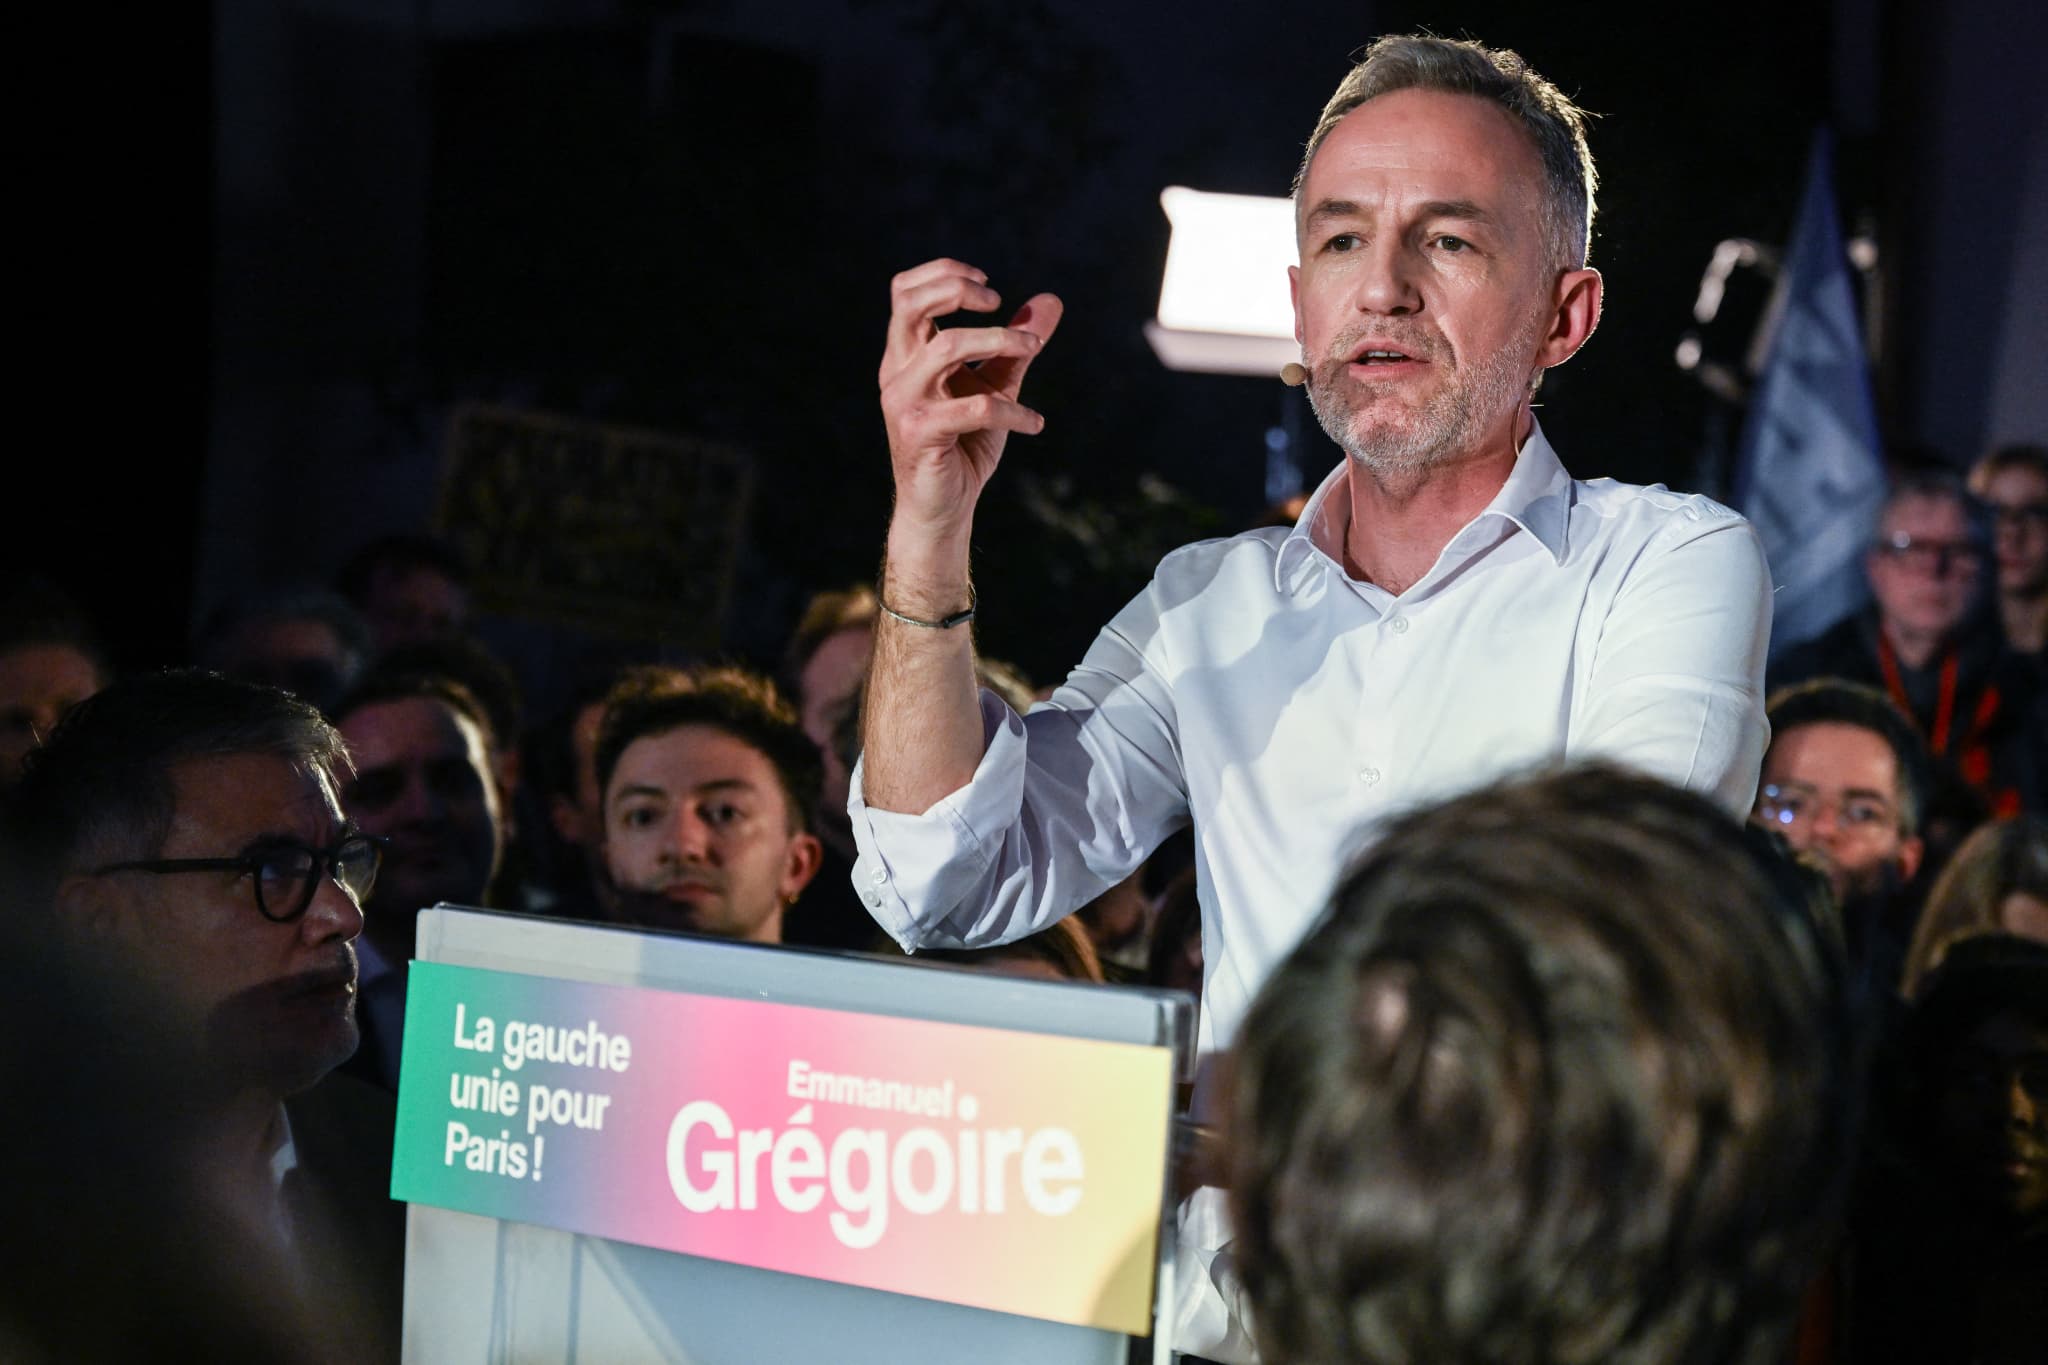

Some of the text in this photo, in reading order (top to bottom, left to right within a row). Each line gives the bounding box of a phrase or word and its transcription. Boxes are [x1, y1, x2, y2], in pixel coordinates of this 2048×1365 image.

[454, 1003, 631, 1072] La gauche
[449, 1067, 611, 1135] unie pour
[787, 1060, 955, 1119] Emmanuel
[666, 1096, 1085, 1250] Grégoire
